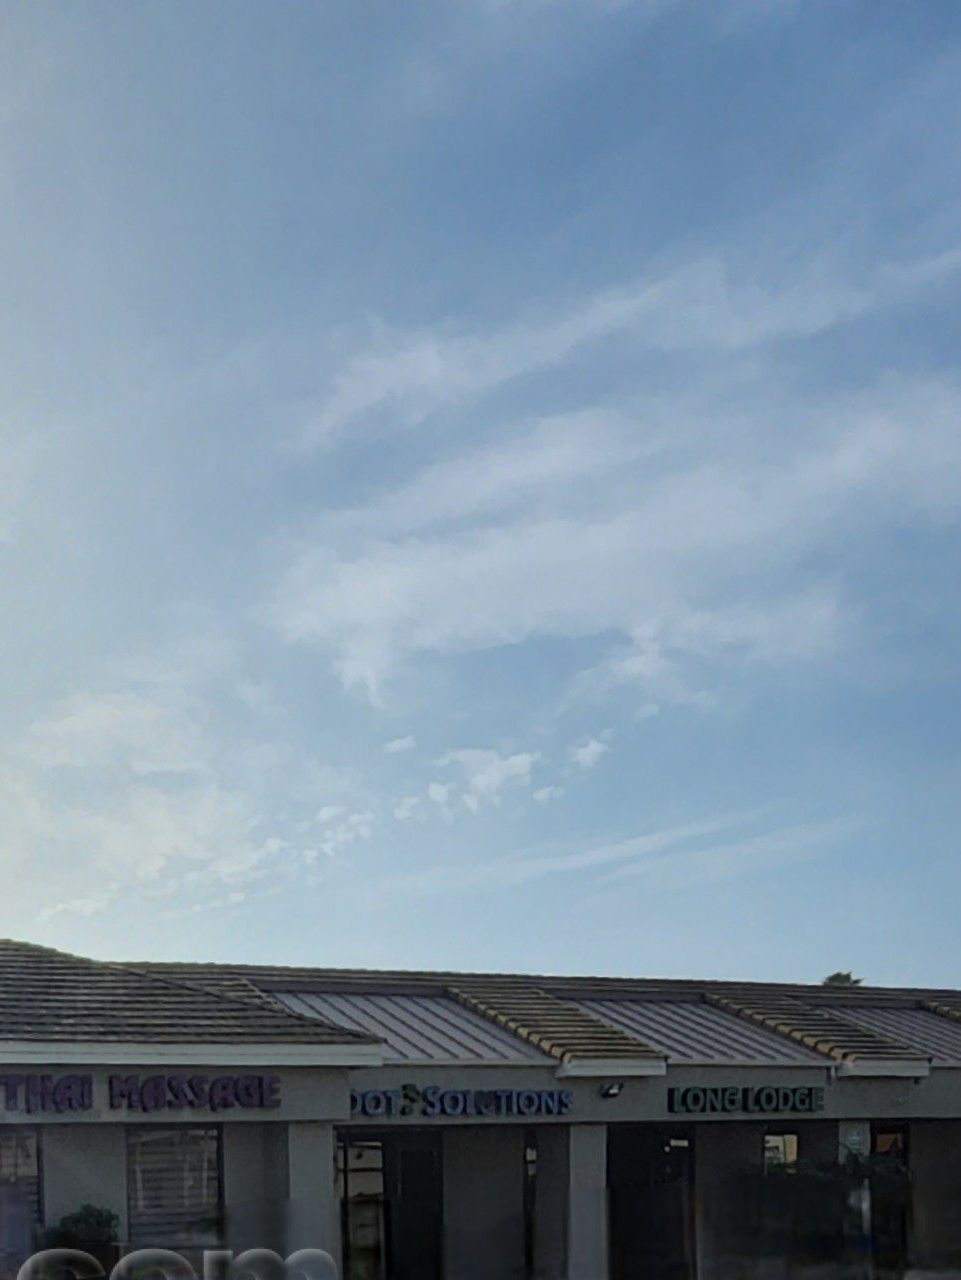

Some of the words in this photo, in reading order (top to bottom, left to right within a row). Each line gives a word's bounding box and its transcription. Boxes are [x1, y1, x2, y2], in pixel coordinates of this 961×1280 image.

[109, 1074, 282, 1112] MASSAGE
[670, 1087, 742, 1113] LONG
[745, 1087, 824, 1112] LODGE
